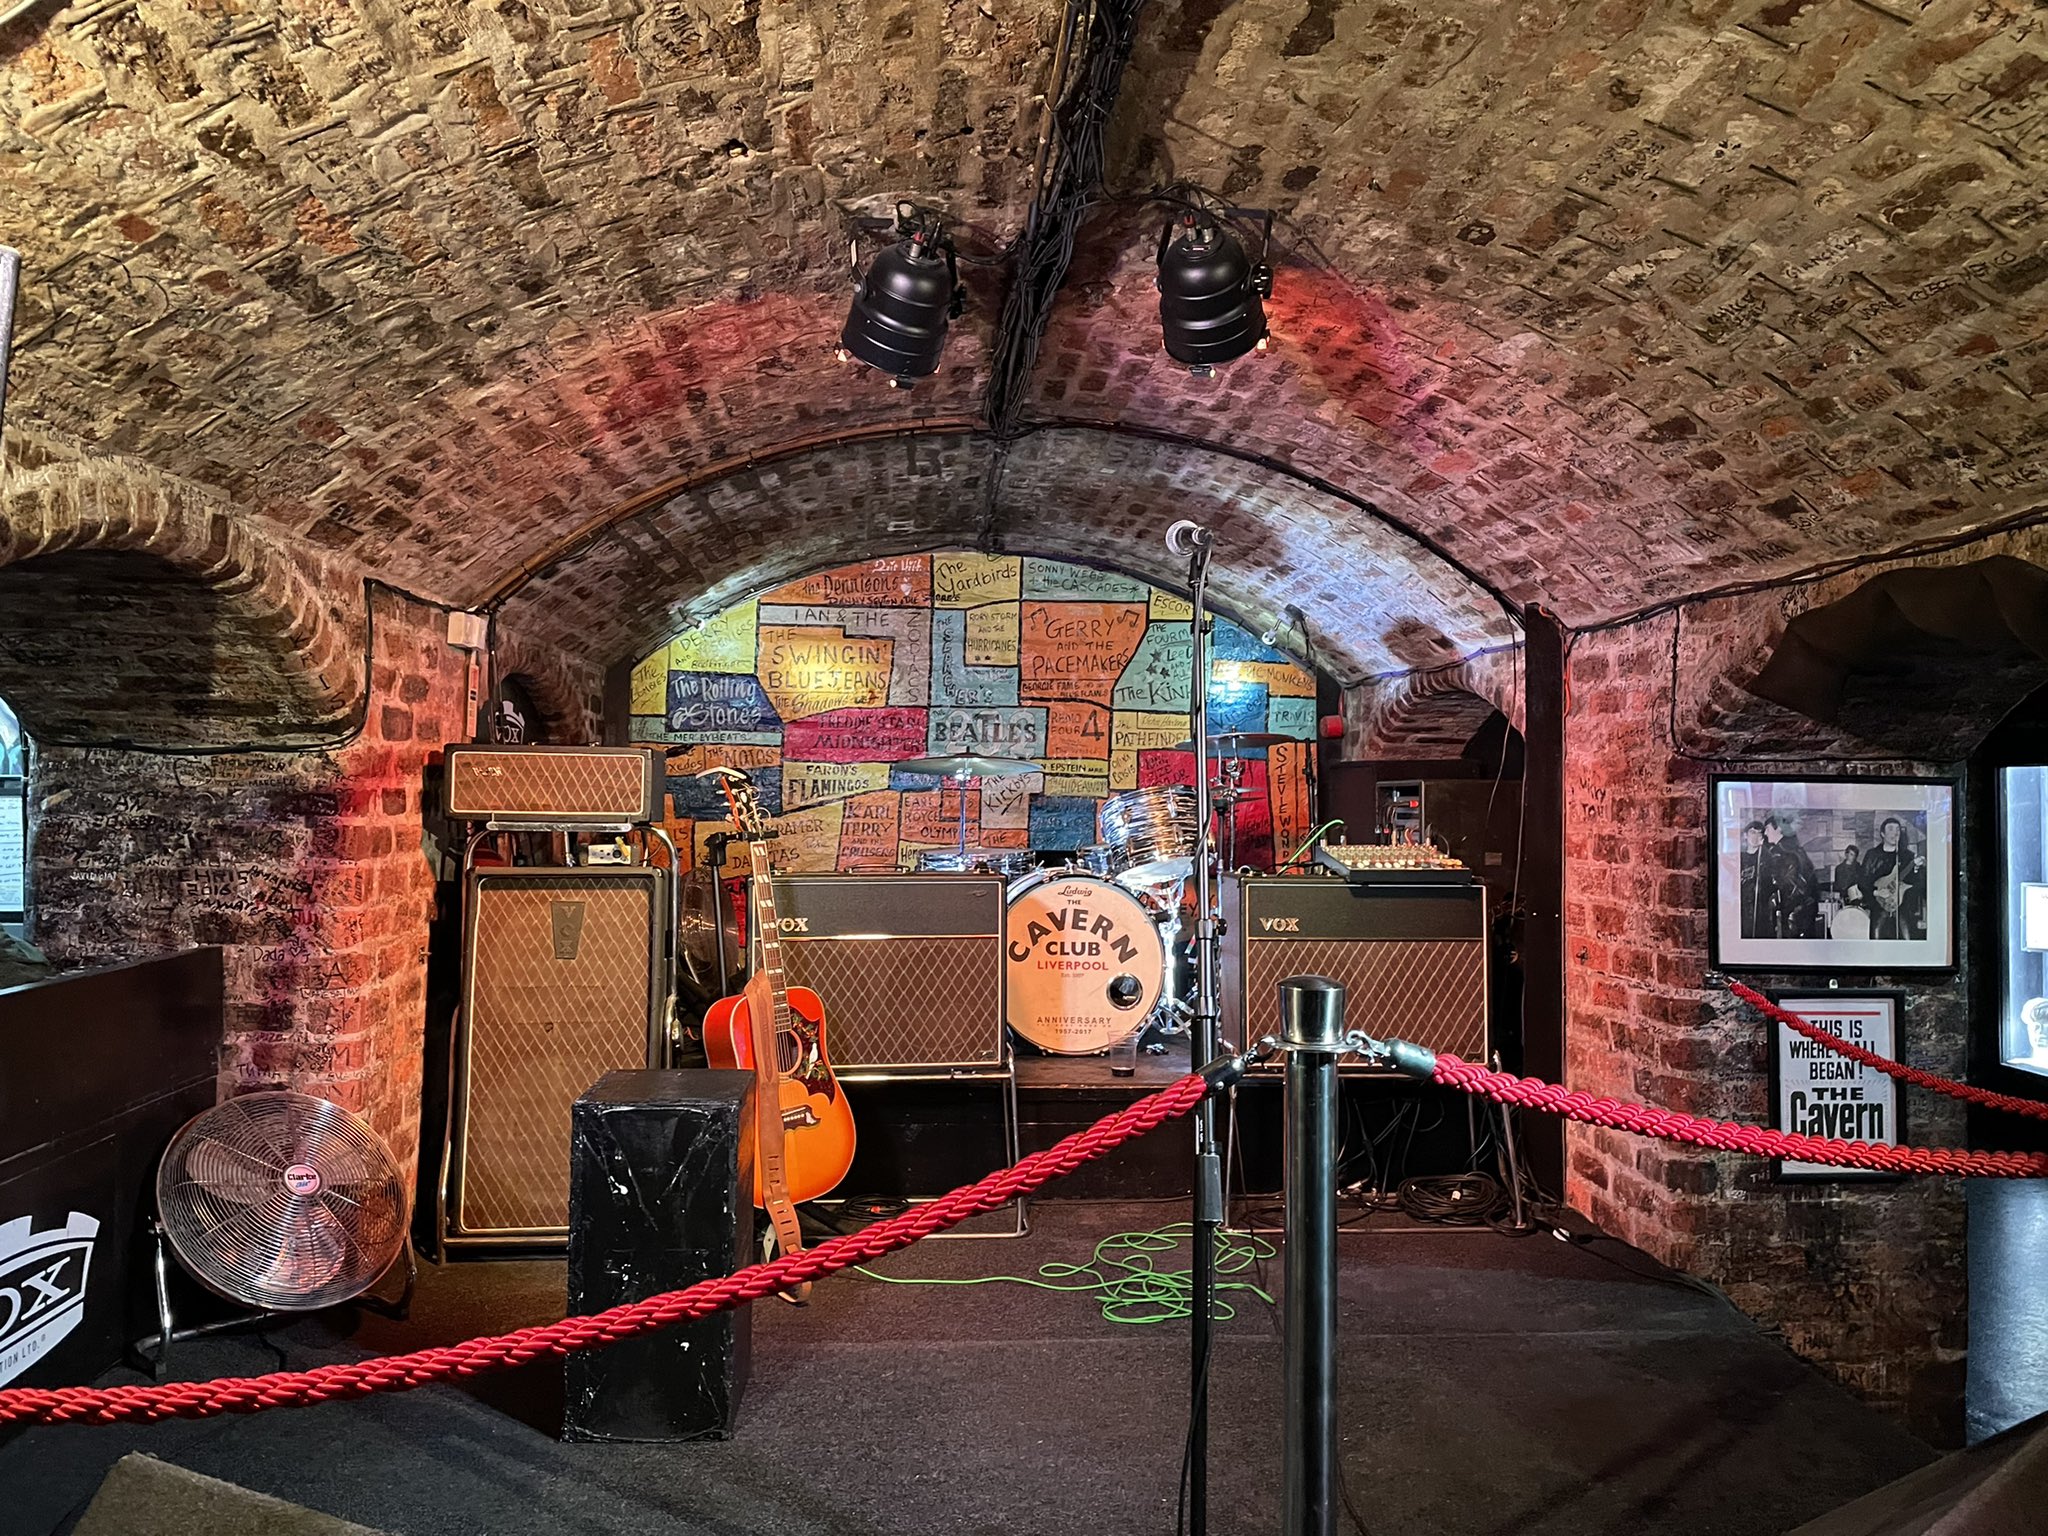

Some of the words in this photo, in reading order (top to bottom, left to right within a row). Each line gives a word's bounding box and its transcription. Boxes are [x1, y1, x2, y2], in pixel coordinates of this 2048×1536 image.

[936, 562, 967, 581] The
[1028, 561, 1065, 574] SONNY
[823, 573, 900, 597] Dennisons
[937, 564, 1018, 594] Yardbirds
[1154, 595, 1190, 615] ESCOR
[679, 616, 730, 651] DERRY
[766, 628, 797, 643] THE
[1046, 617, 1115, 640] GERRY
[1149, 622, 1167, 633] THE
[1056, 641, 1080, 651] AND
[1085, 640, 1113, 651] THE
[1146, 629, 1189, 645] FOURM
[967, 639, 1017, 653] HURRICANES
[795, 608, 830, 622] IAN
[837, 609, 847, 623] &
[851, 610, 890, 627] THE
[906, 611, 923, 702] ZODIACS
[1032, 648, 1130, 676] PACEMAKERS
[637, 665, 661, 683] The
[671, 675, 699, 699] The
[701, 676, 758, 702] Rolling
[1116, 686, 1147, 702] The
[1147, 680, 1191, 706] KiN
[673, 702, 762, 729] Stones
[934, 714, 1036, 744] BEATLES
[1051, 725, 1081, 736] FOUR
[1080, 709, 1105, 742] 4
[650, 731, 669, 741] THE
[805, 764, 859, 776] FARON'S
[1050, 762, 1087, 773] EPSTEIN
[983, 774, 1005, 790] THE
[786, 778, 870, 807] FLAMINGOS
[983, 773, 1032, 813] Kirkbys
[846, 801, 895, 819] KARL
[843, 822, 894, 837] TERRY
[920, 826, 977, 839] OLYMPCS
[186, 883, 232, 897] 2016
[1057, 885, 1093, 897] Ludwig
[1259, 917, 1300, 932] VOX
[1008, 907, 1139, 964] CAVERN
[253, 946, 285, 963] Dada
[1045, 941, 1101, 956] CLUB
[1037, 961, 1109, 971] LIVERPOOL
[1036, 1016, 1112, 1025] ANNIVERSARY
[1849, 1020, 1863, 1038] IS
[1054, 1028, 1093, 1036] 1957-2017
[1809, 1061, 1863, 1080] BEGAN!
[1812, 1088, 1864, 1100] THE
[1790, 1091, 1884, 1139] Cavern
[287, 1173, 317, 1181] Clarke
[0, 1256, 71, 1337] OX
